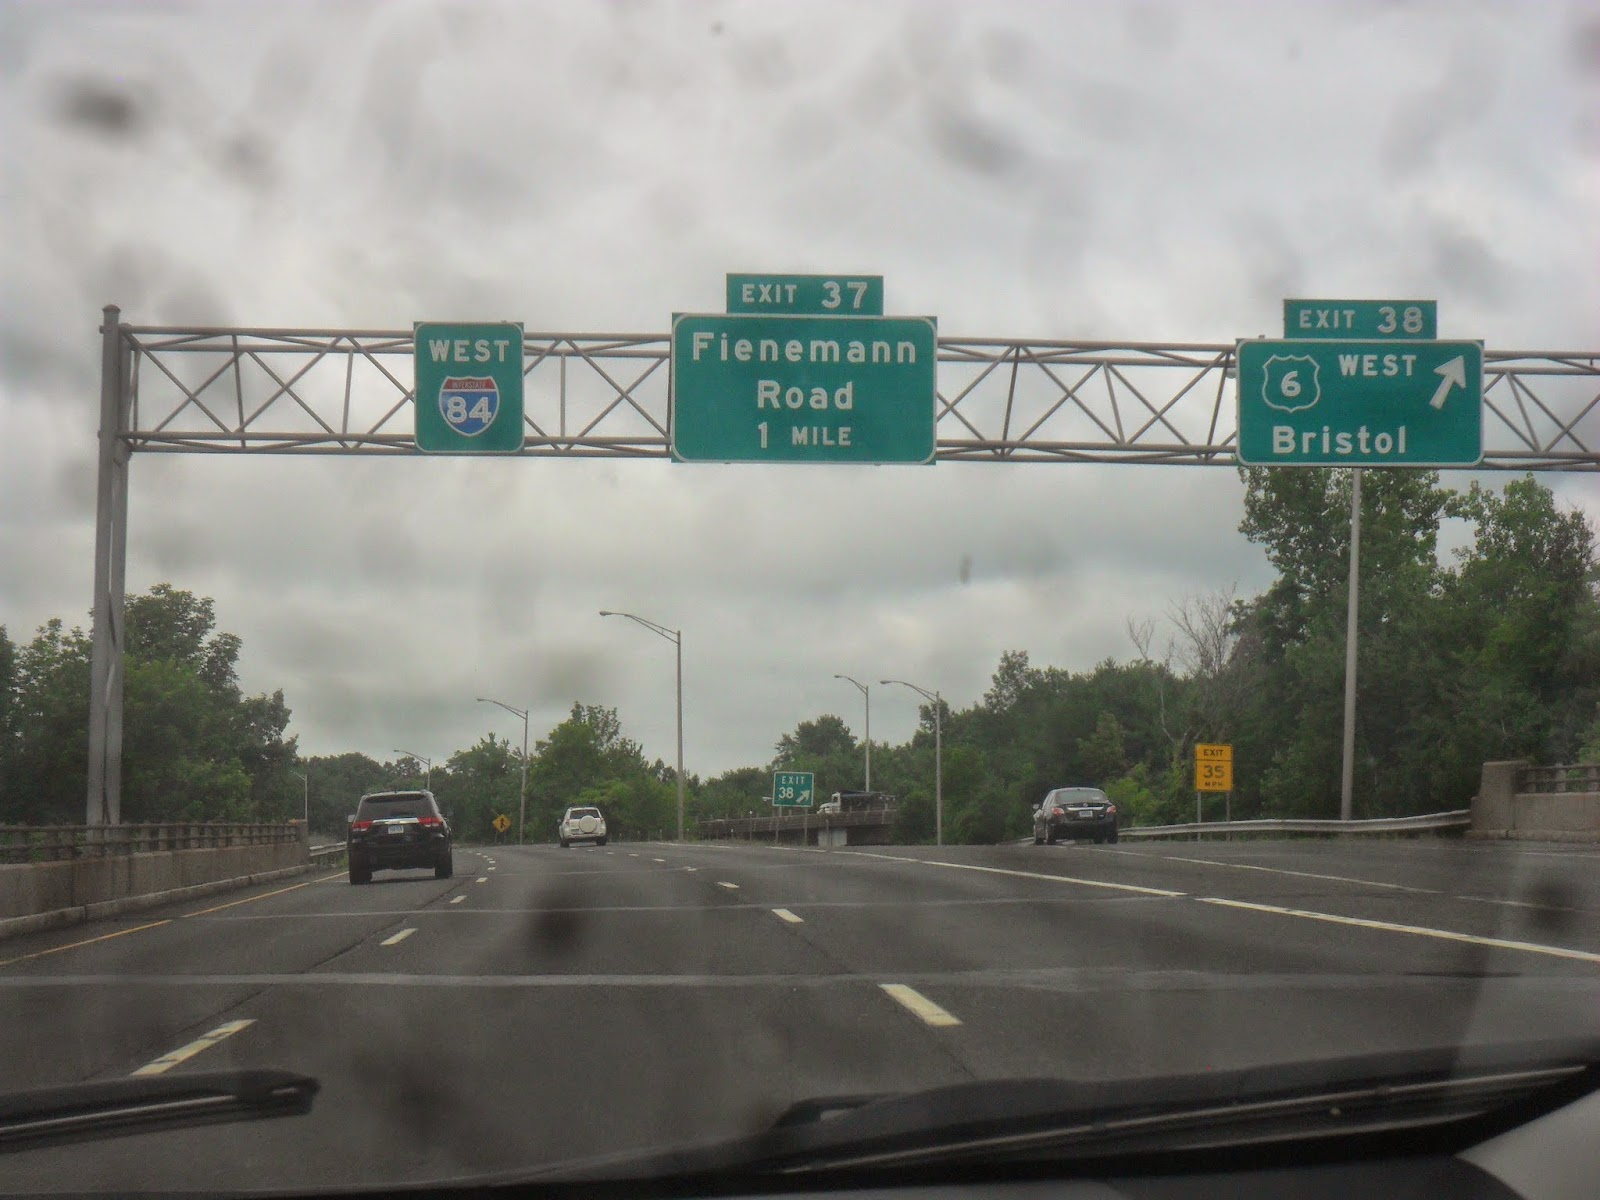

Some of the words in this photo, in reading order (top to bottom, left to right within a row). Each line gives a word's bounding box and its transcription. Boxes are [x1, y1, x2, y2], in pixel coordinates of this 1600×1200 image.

[742, 283, 798, 304] EXIT
[821, 280, 869, 309] 37
[1299, 309, 1356, 329] EXIT
[1377, 306, 1424, 334] 38
[428, 339, 510, 362] WEST
[692, 331, 917, 364] Fienemann
[1338, 354, 1418, 377] WEST
[757, 379, 854, 410] Road
[1280, 370, 1302, 398] 6
[446, 396, 493, 424] 84
[757, 421, 769, 449] 1
[791, 426, 853, 447] MILE
[1272, 425, 1407, 455] Bristol
[781, 776, 805, 784] EXIT
[1203, 765, 1226, 779] 35
[778, 787, 794, 799] 38
